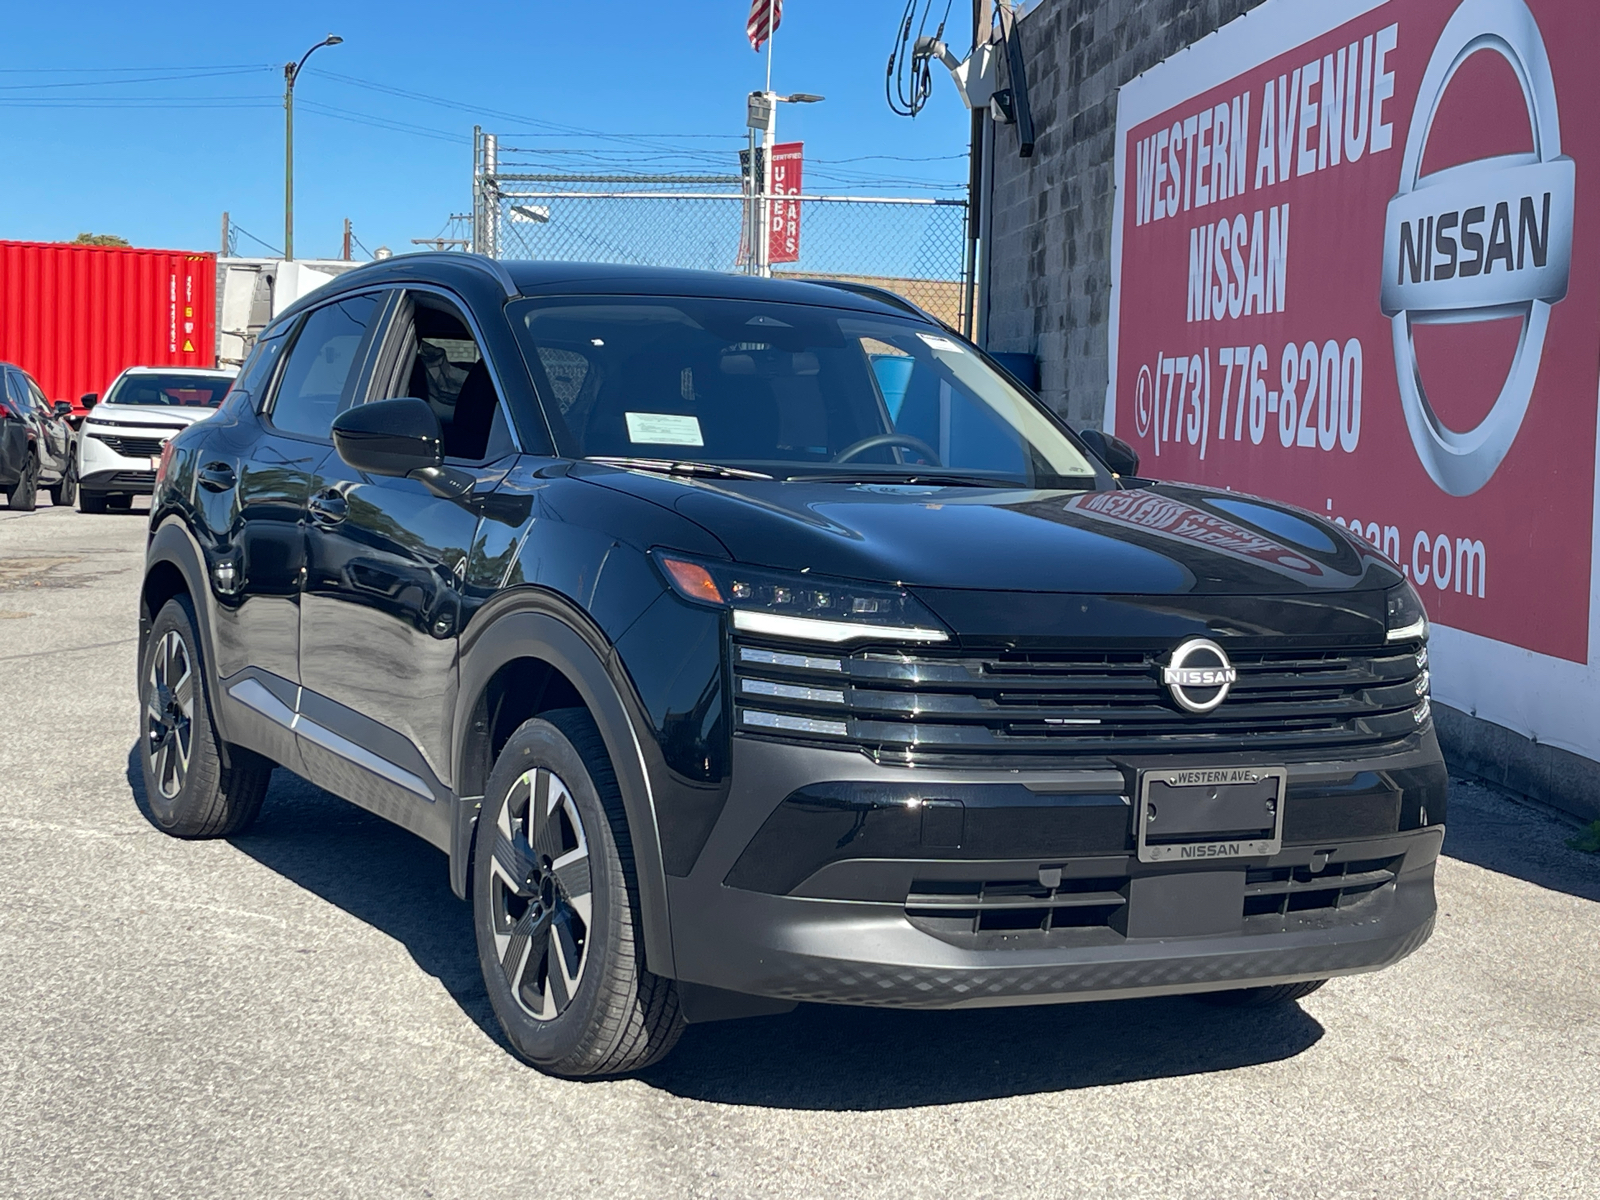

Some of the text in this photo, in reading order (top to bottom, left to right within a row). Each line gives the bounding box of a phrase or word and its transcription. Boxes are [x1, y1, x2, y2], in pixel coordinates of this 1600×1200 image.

[1136, 22, 1398, 227] WESTERN AVENUE
[774, 166, 785, 232] USED
[786, 187, 798, 253] CARS
[1186, 203, 1290, 323] NISSAN
[1398, 192, 1551, 285] NISSAN
[1154, 337, 1363, 461] (773) 776-8200
[1166, 670, 1236, 683] NISSAN
[1178, 771, 1228, 784] WESTERN
[1181, 843, 1240, 858] NISSAN
